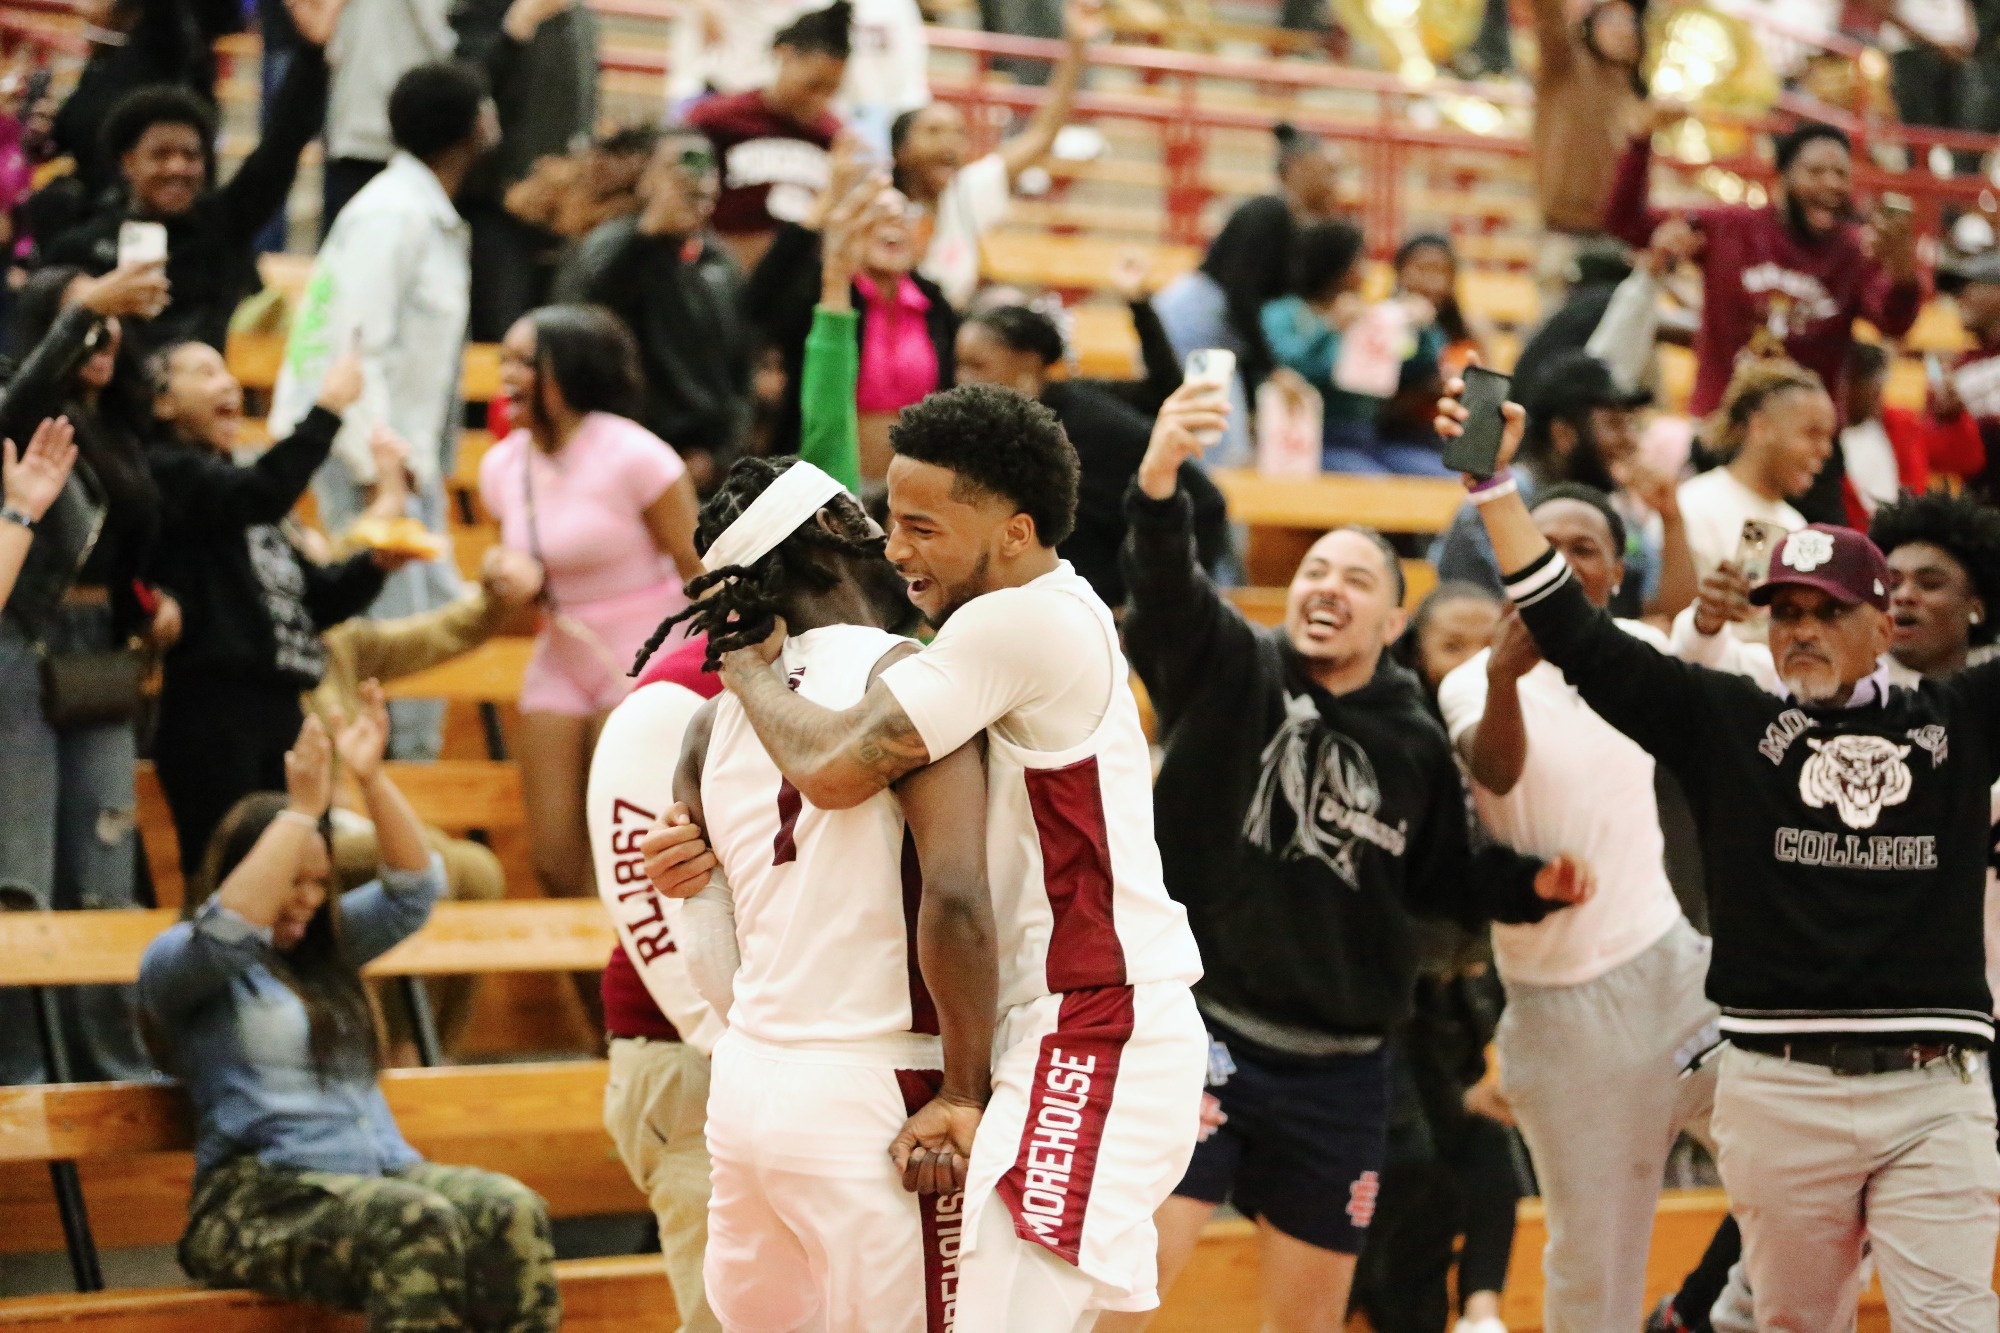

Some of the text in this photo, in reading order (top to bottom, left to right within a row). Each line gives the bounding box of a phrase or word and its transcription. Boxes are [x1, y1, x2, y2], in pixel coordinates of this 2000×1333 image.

[612, 798, 677, 966] RL1867
[1774, 827, 1938, 871] COLLEGE
[1021, 1048, 1096, 1246] MOREHOUSE
